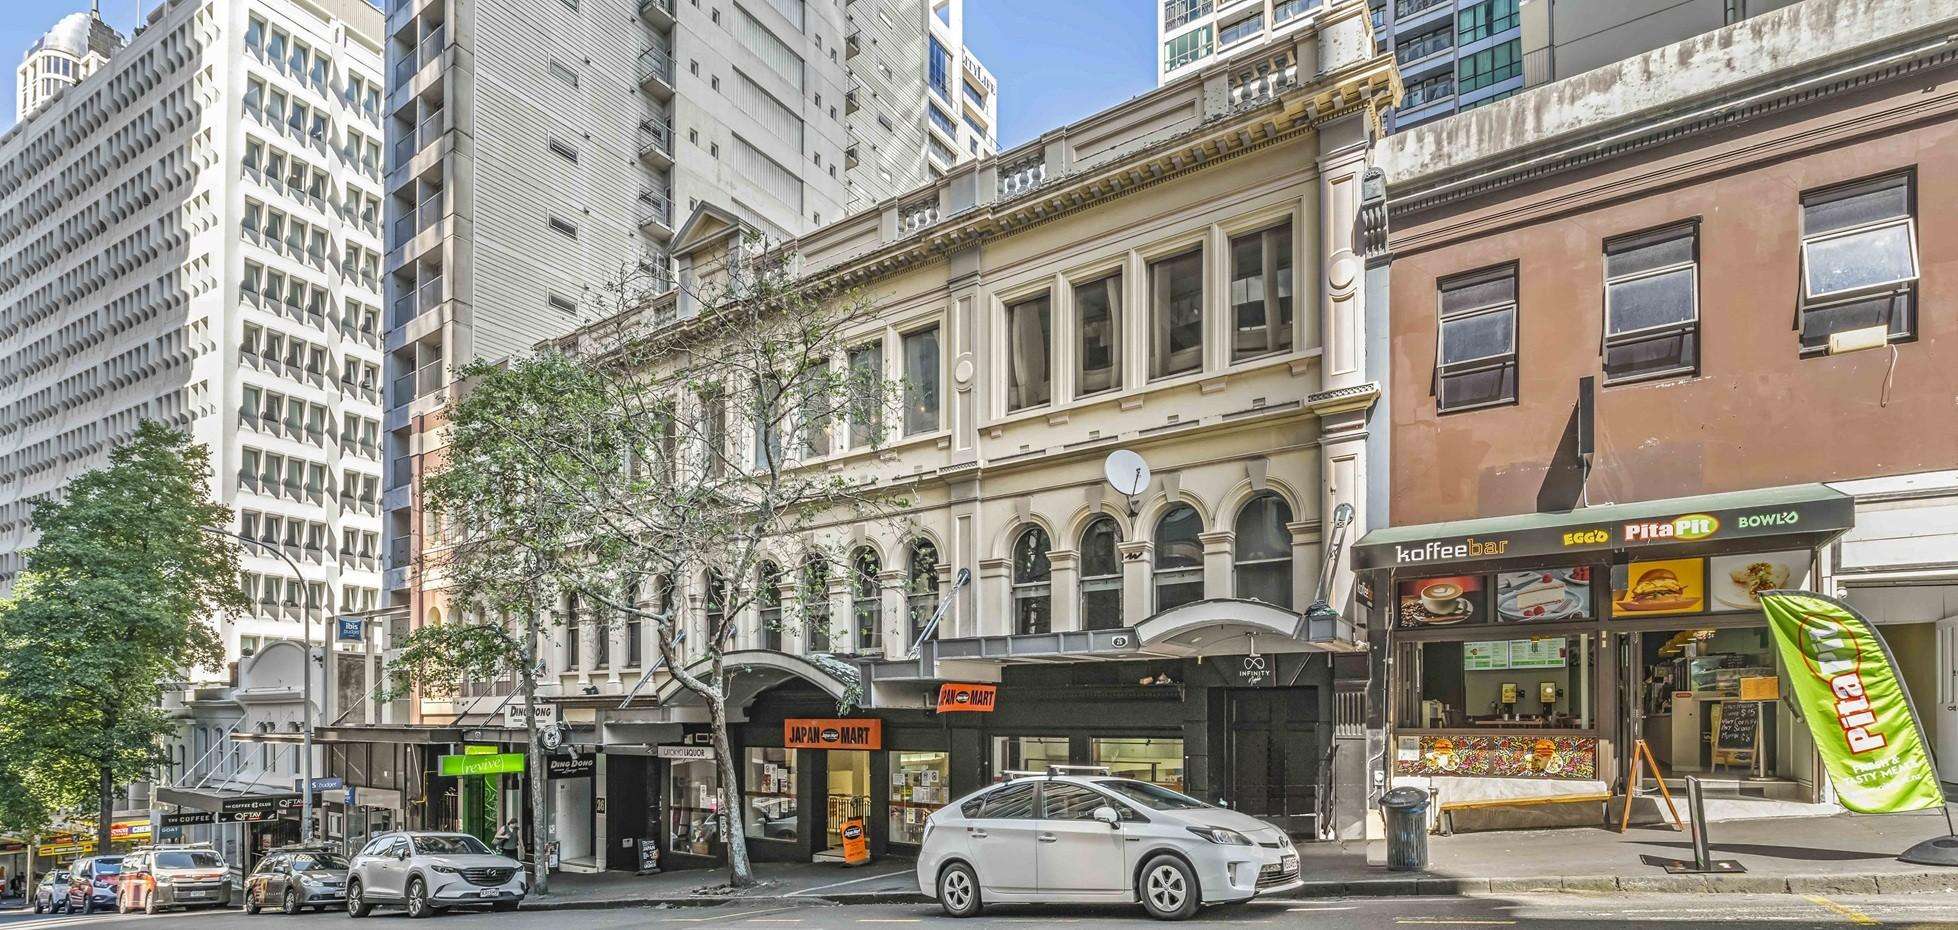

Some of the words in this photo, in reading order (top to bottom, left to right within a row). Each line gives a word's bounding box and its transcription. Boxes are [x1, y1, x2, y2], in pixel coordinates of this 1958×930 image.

[345, 622, 359, 630] ibis
[970, 690, 994, 706] MART
[1835, 671, 1888, 755] Pita
[789, 726, 820, 744] JAPAN
[840, 726, 871, 745] MART
[683, 749, 705, 757] LIQUOR
[464, 758, 501, 774] revive
[550, 759, 570, 769] DING
[571, 759, 593, 768] DONG
[180, 814, 210, 823] COFFEE
